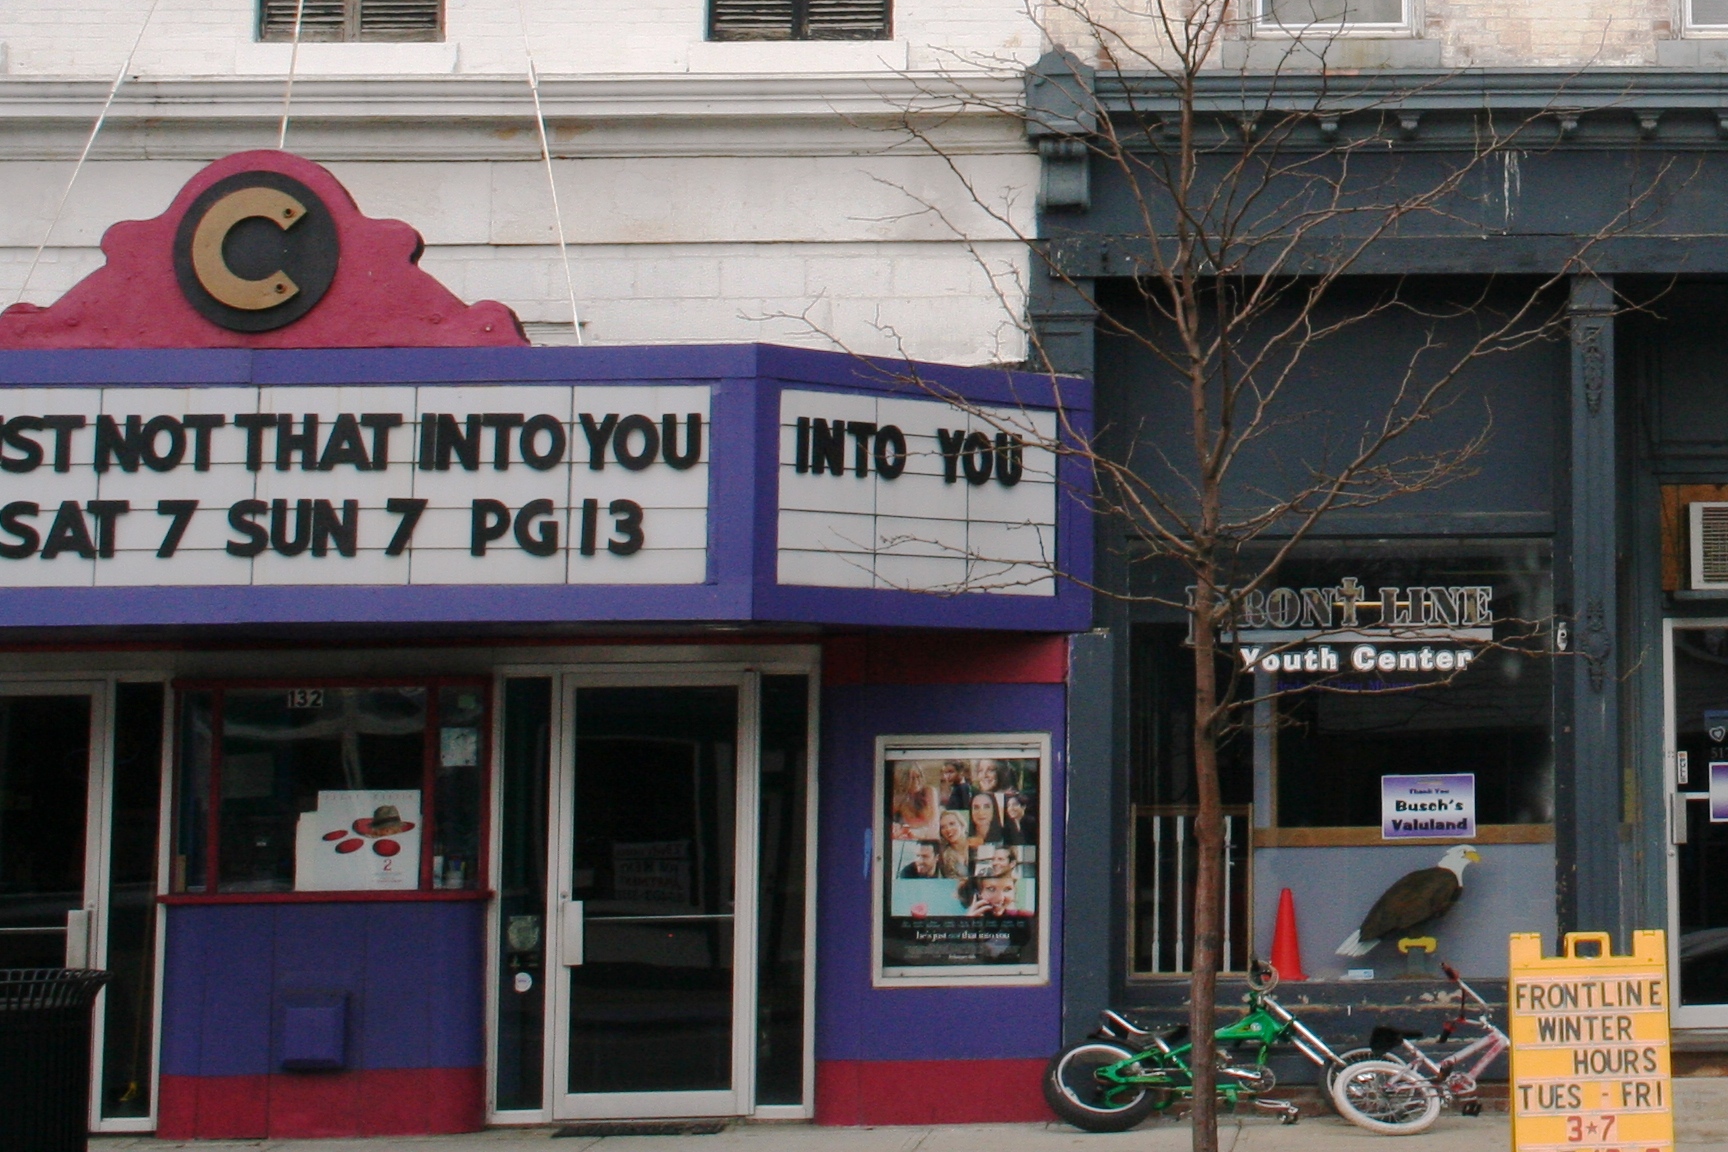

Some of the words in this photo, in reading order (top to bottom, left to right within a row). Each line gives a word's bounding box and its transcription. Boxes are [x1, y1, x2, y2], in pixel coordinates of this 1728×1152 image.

[192, 185, 308, 311] C
[0, 414, 87, 473] ST
[94, 413, 226, 473] NOT
[234, 412, 402, 473] THAT
[417, 412, 567, 472] INTO
[578, 411, 702, 472] YOU
[795, 416, 906, 480] INTO
[938, 428, 1023, 487] YOU
[0, 499, 130, 560] SAT
[156, 499, 200, 559] 7
[226, 498, 359, 559] SUN
[384, 498, 428, 558] 7
[1380, 586, 1492, 627] LINE
[1240, 645, 1339, 672] Youth
[1351, 643, 1474, 673] Center
[289, 689, 322, 707] 132
[1395, 799, 1464, 812] Busch's
[1391, 818, 1468, 831] Valuland
[383, 859, 392, 871] 2
[1515, 981, 1662, 1010] FRONTLINE
[1538, 1015, 1633, 1043] WINTER
[1573, 1047, 1657, 1075] HOURS
[1518, 1083, 1582, 1110] TUES
[1621, 1081, 1663, 1107] FRI
